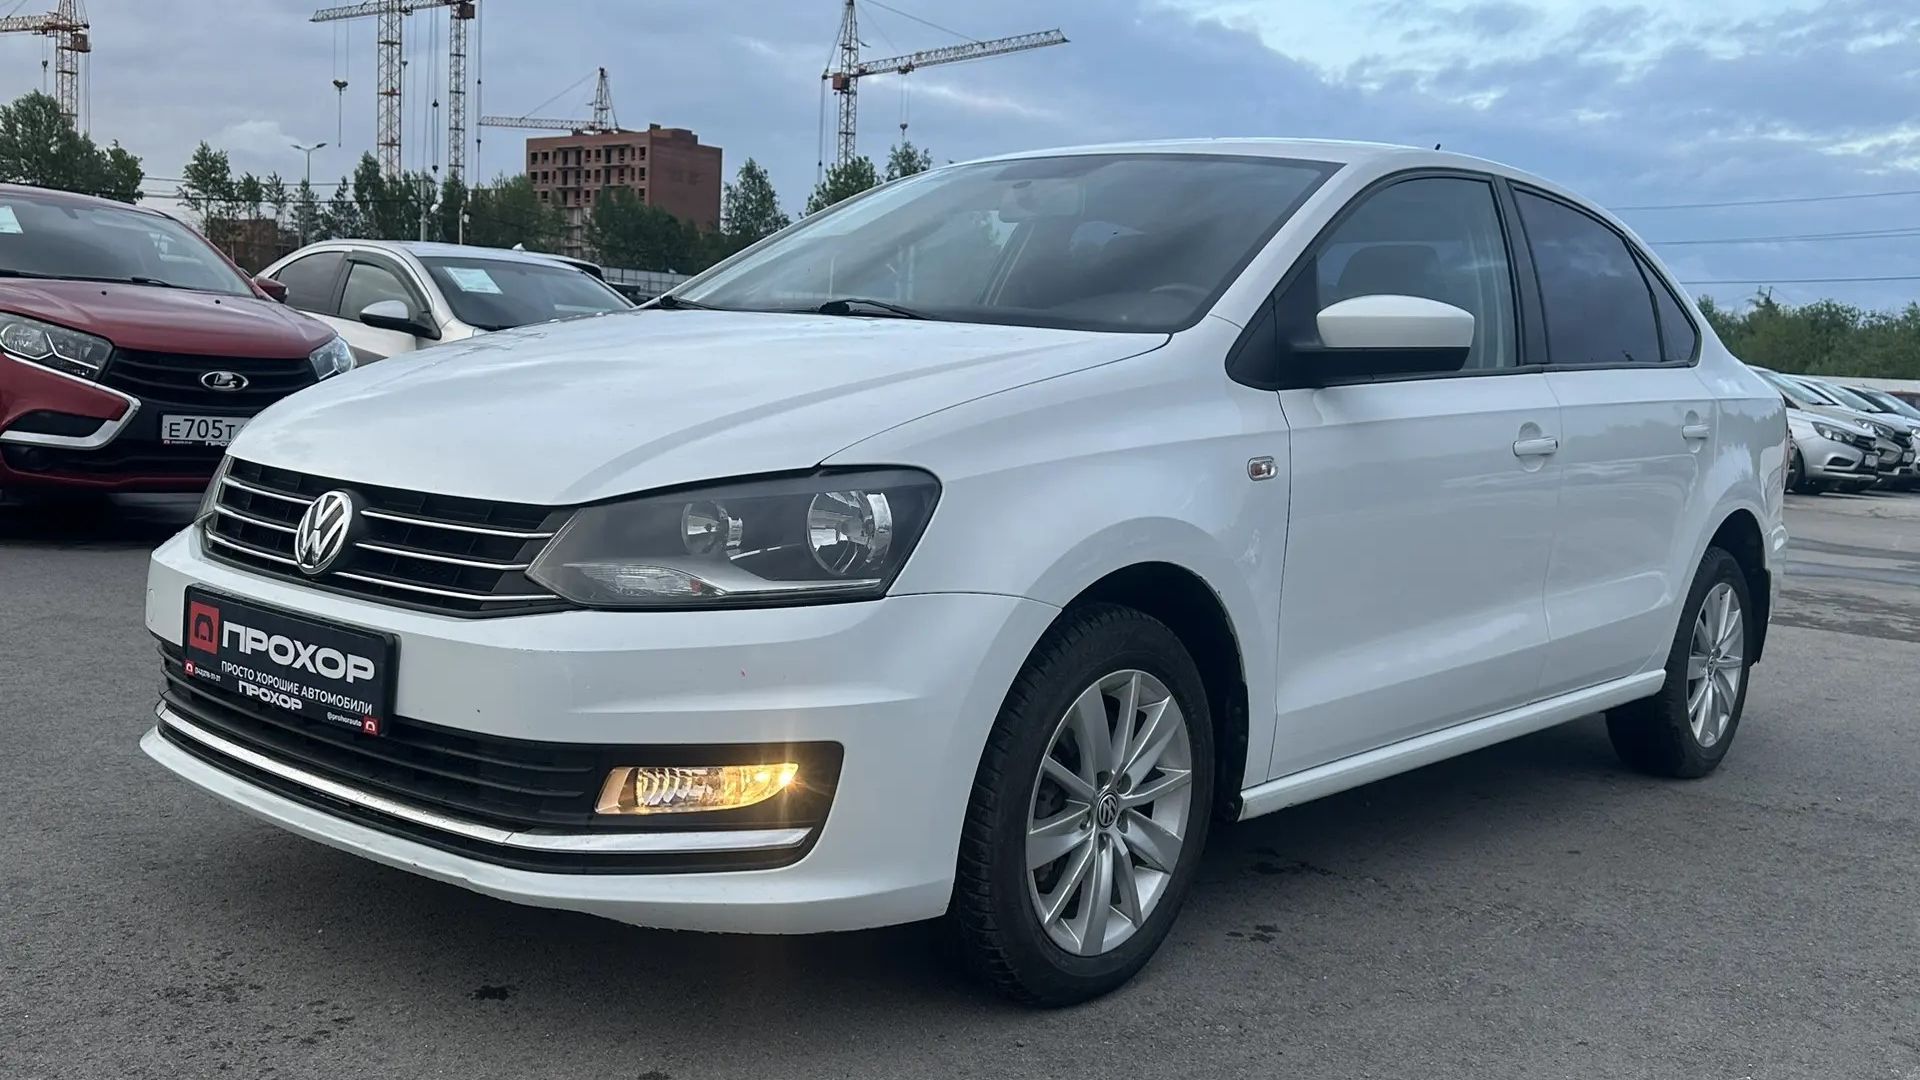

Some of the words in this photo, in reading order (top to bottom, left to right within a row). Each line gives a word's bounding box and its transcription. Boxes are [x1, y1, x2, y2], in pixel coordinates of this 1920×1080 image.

[221, 620, 375, 684] ПРОХОР
[221, 660, 255, 681] ПРОСТО
[256, 671, 300, 695] ХОРОШИЕ
[301, 685, 373, 716] АВТОМОБИЛИ
[238, 680, 303, 710] ПРОХОР
